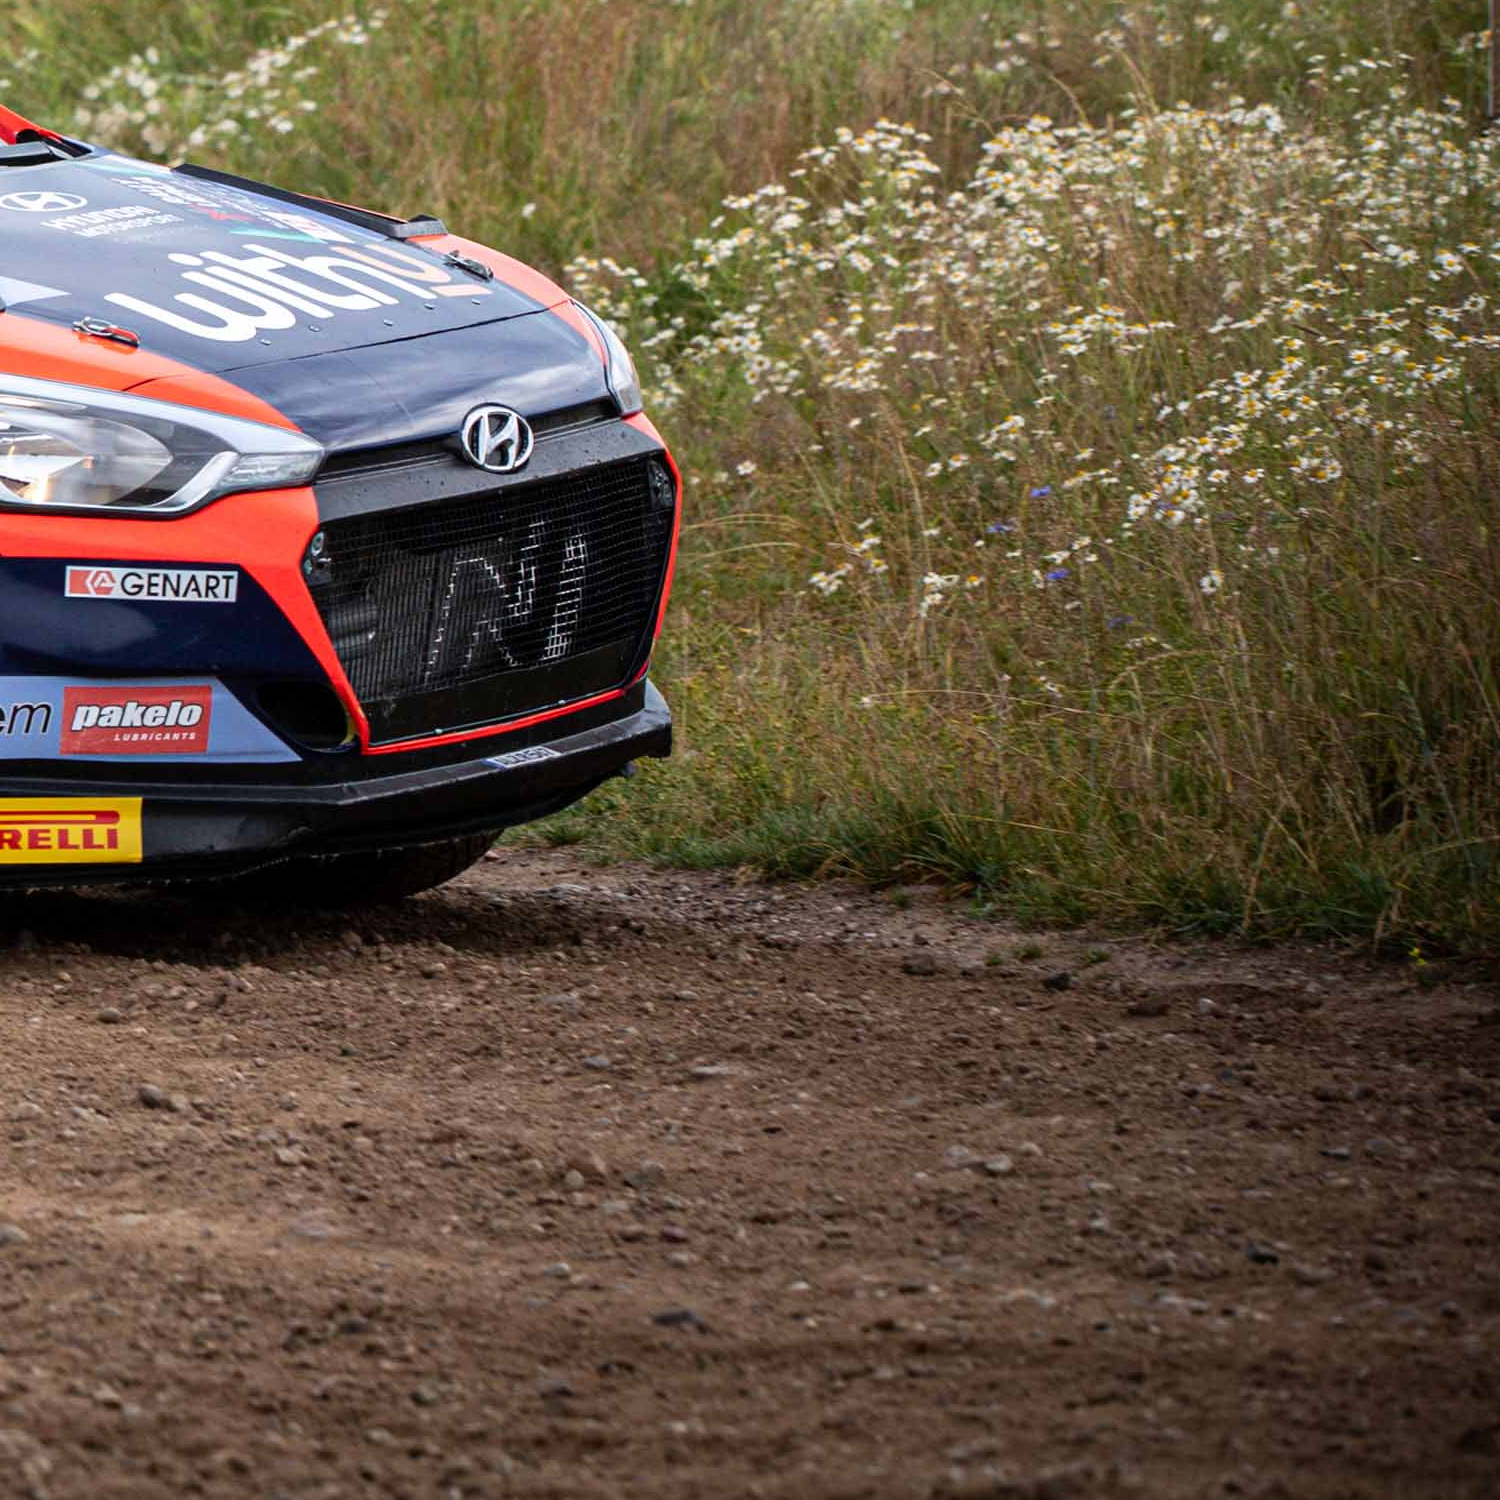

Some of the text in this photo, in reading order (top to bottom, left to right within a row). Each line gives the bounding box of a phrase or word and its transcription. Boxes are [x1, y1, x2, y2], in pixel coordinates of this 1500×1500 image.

[39, 205, 162, 229] HYUNDAI
[71, 214, 184, 237] MOTORSPORT
[104, 244, 493, 343] withu
[121, 571, 236, 601] GENART
[72, 700, 204, 732] pakelo
[114, 731, 197, 741] LUBRICANTS
